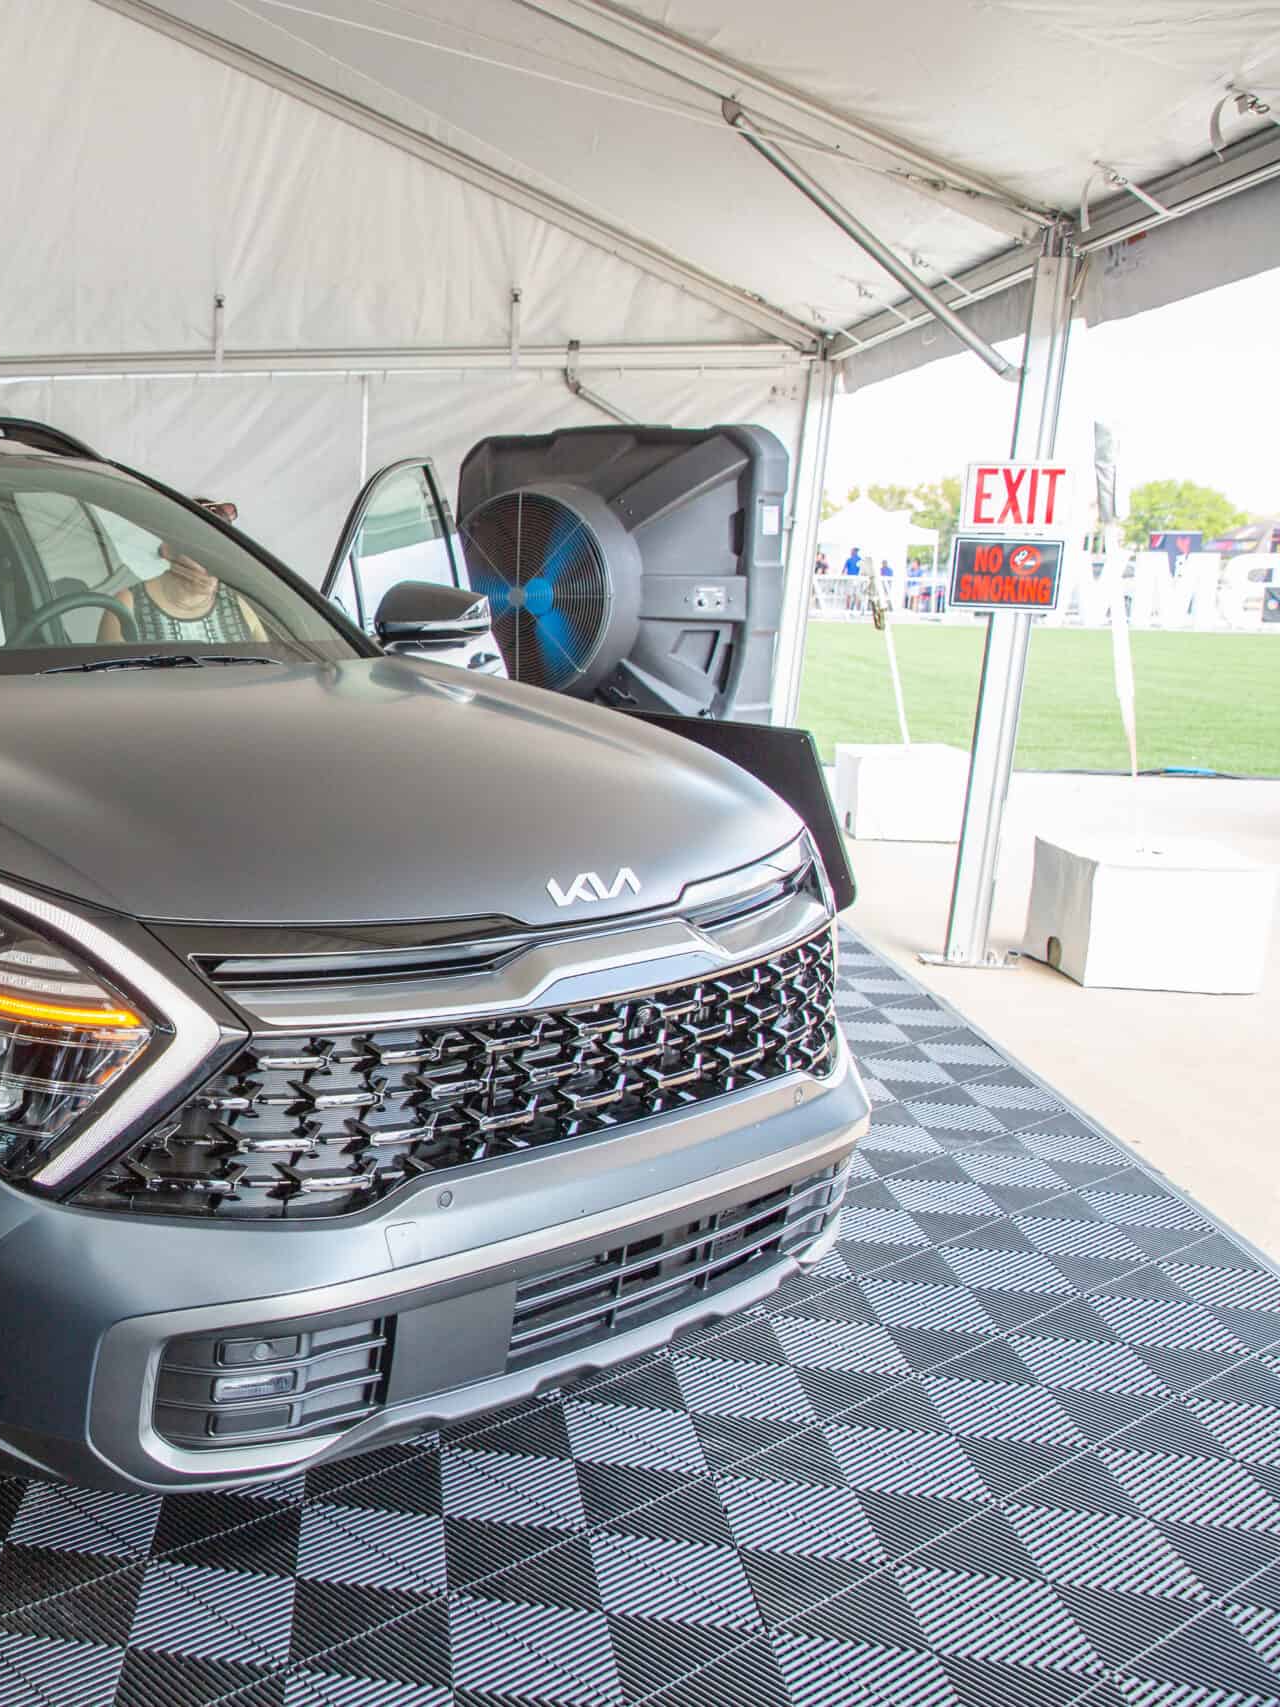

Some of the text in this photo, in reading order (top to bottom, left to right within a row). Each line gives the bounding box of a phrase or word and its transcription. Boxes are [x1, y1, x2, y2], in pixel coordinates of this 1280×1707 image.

[972, 468, 1066, 525] EXIT
[974, 544, 1003, 574] NO
[959, 573, 1052, 603] SMOKING
[546, 866, 642, 906] KIA
